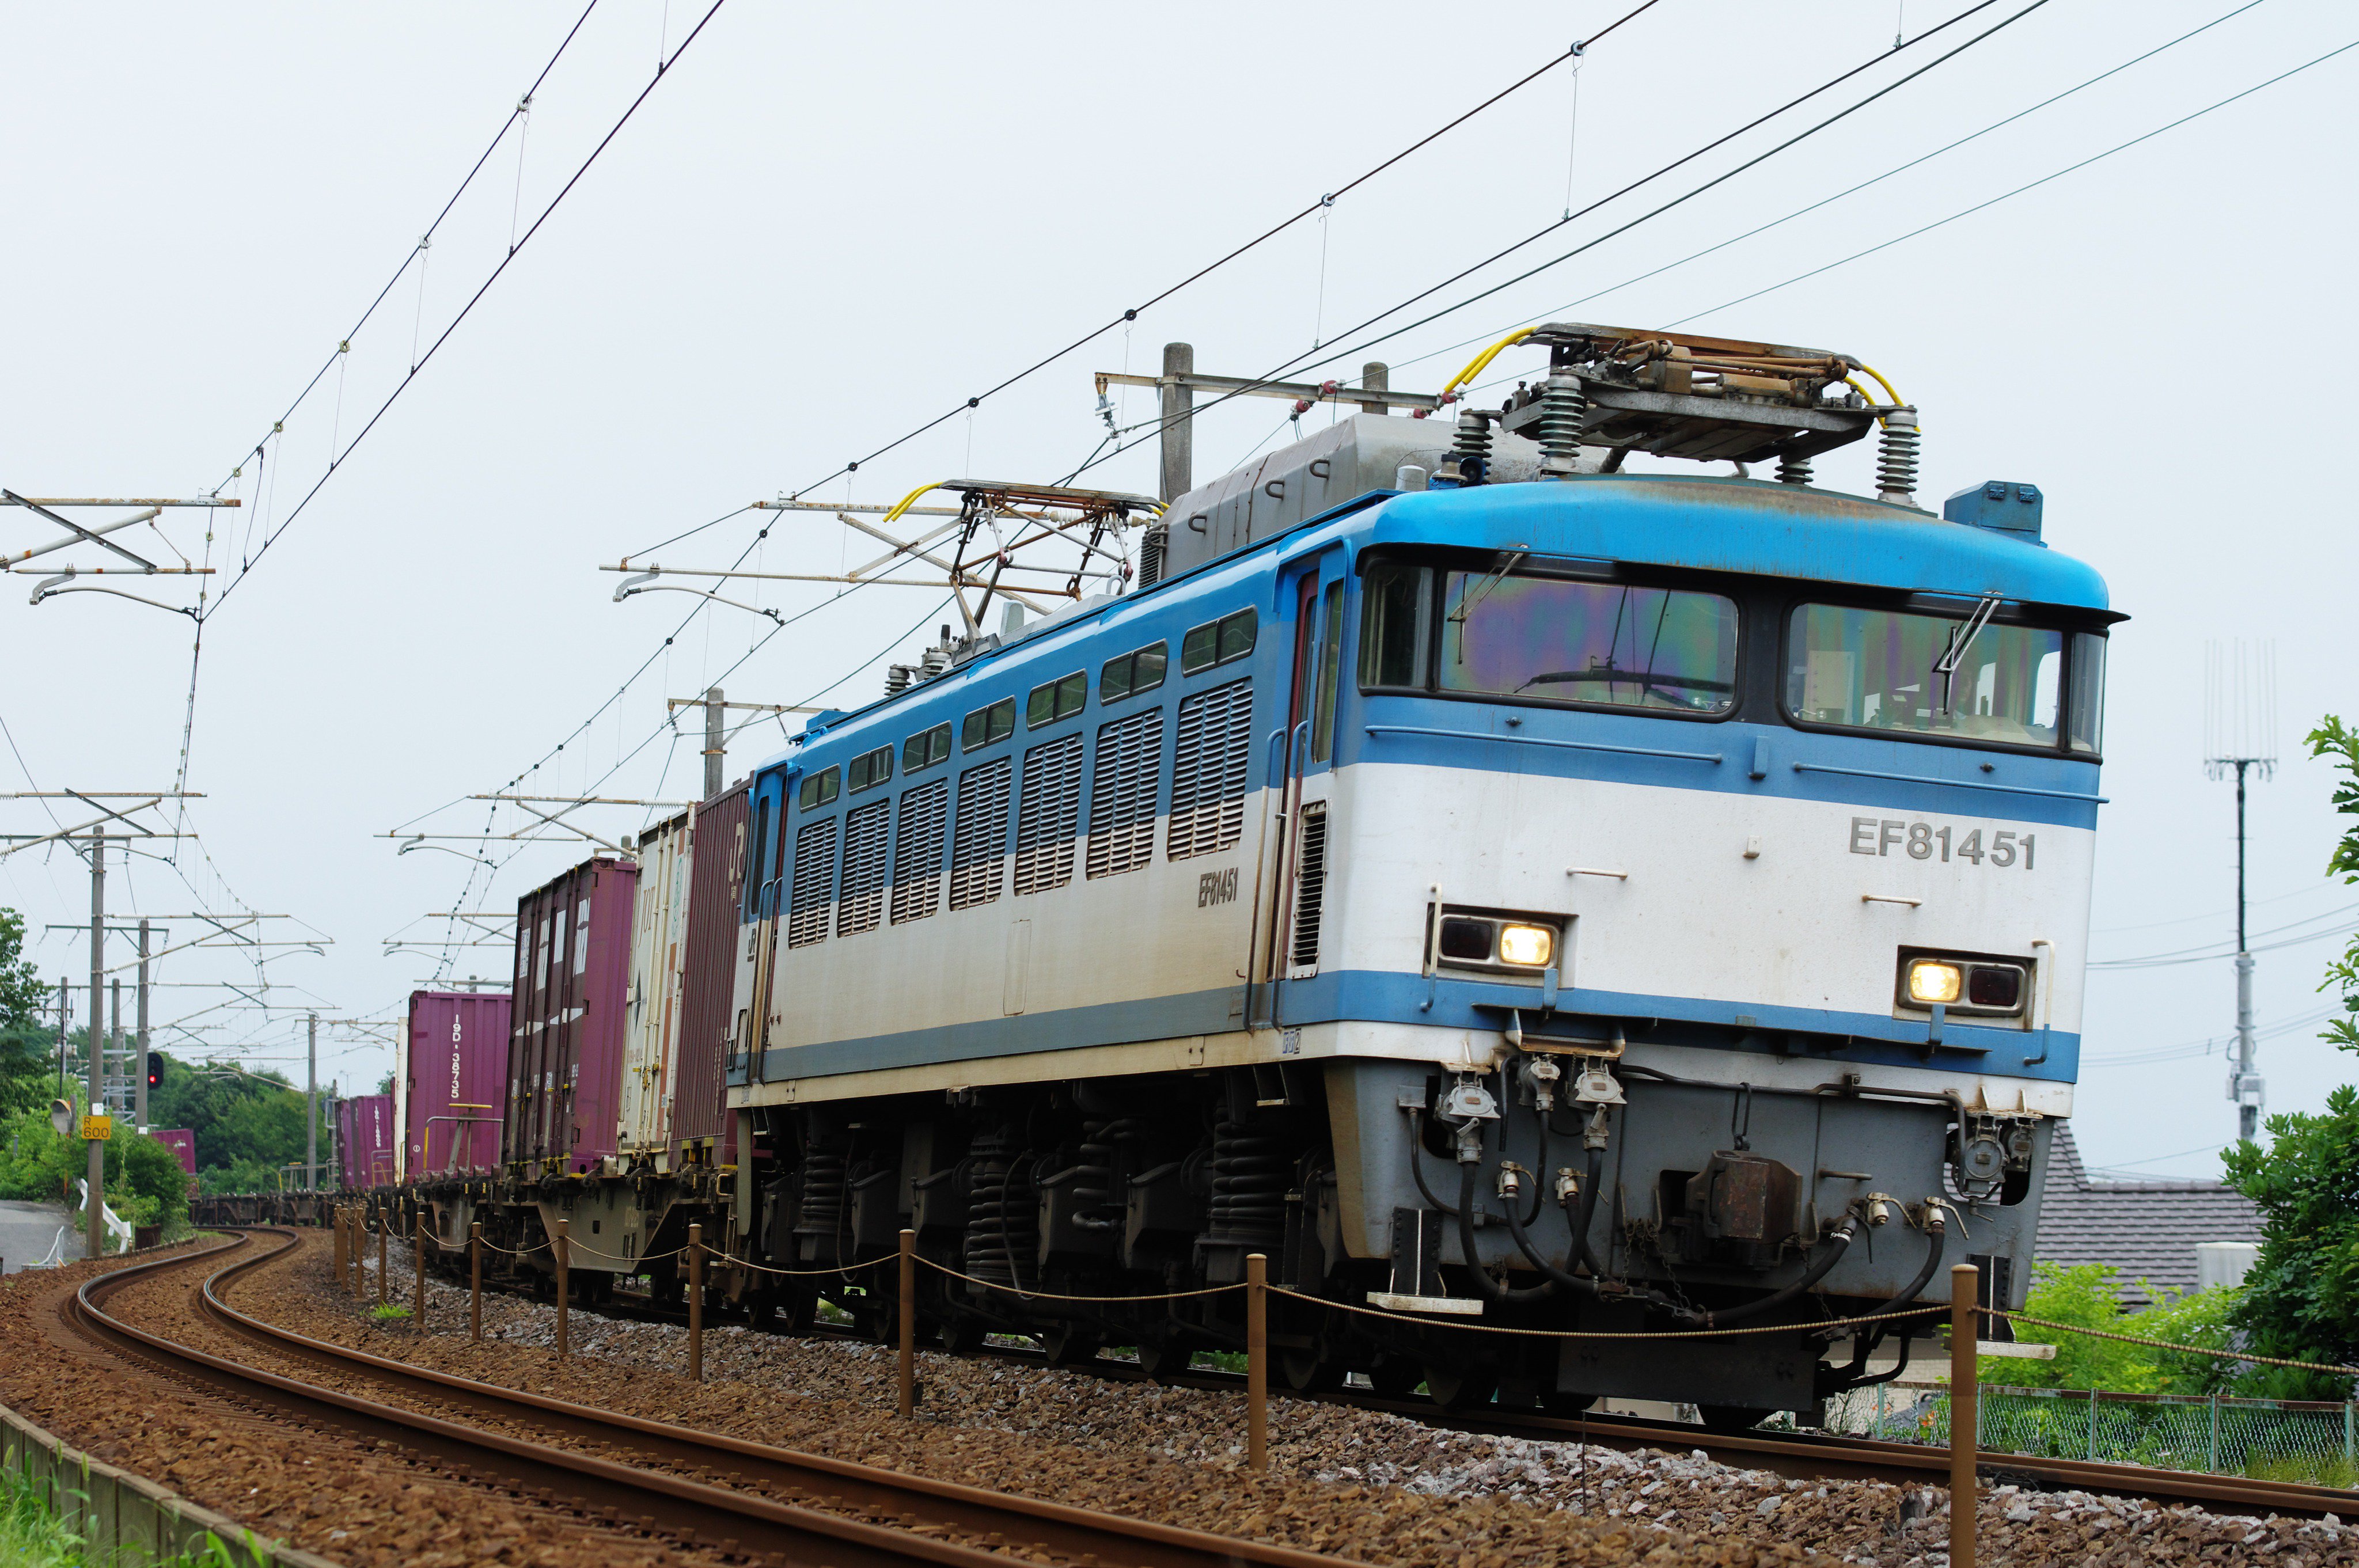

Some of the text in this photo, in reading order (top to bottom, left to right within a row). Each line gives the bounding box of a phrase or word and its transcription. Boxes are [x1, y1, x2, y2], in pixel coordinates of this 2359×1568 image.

[1849, 816, 2035, 870] EF81451
[1197, 867, 1239, 908] EF81451
[83, 1127, 109, 1138] 600
[84, 1117, 91, 1126] R
